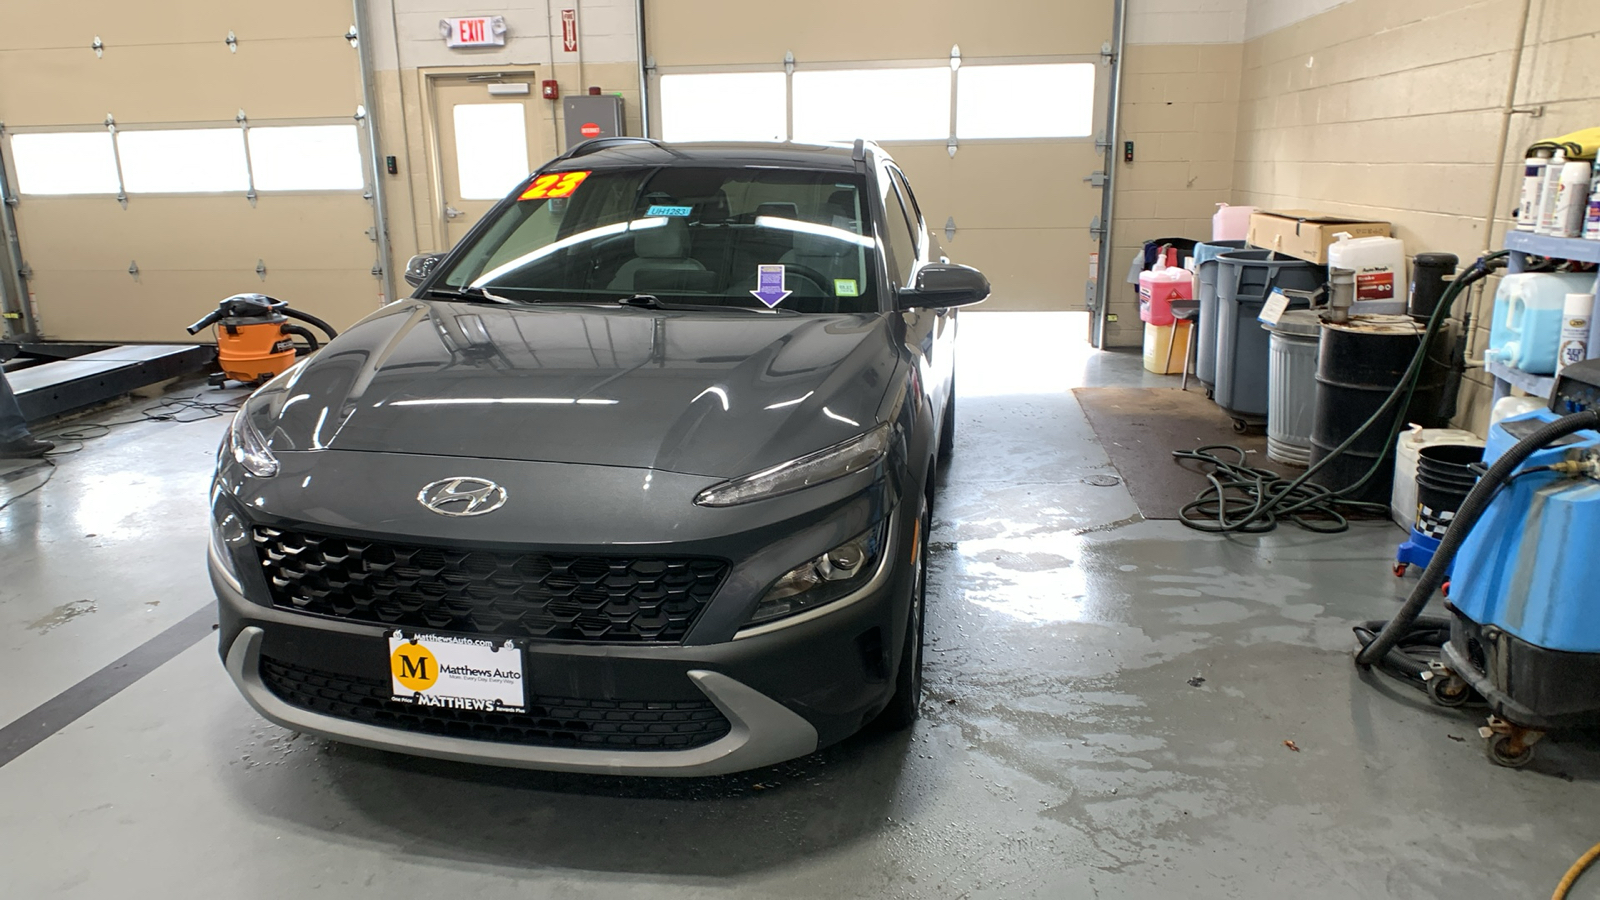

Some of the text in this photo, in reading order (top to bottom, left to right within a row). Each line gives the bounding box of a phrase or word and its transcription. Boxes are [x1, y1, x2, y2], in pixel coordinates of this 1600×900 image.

[459, 20, 485, 43] EXIT
[521, 171, 587, 199] 23
[651, 207, 687, 216] UH1283
[413, 633, 493, 647] MatthewsAuto.com
[398, 654, 431, 681] M
[440, 664, 521, 680] Matthews Auto
[418, 694, 495, 712] MATTHEWS
